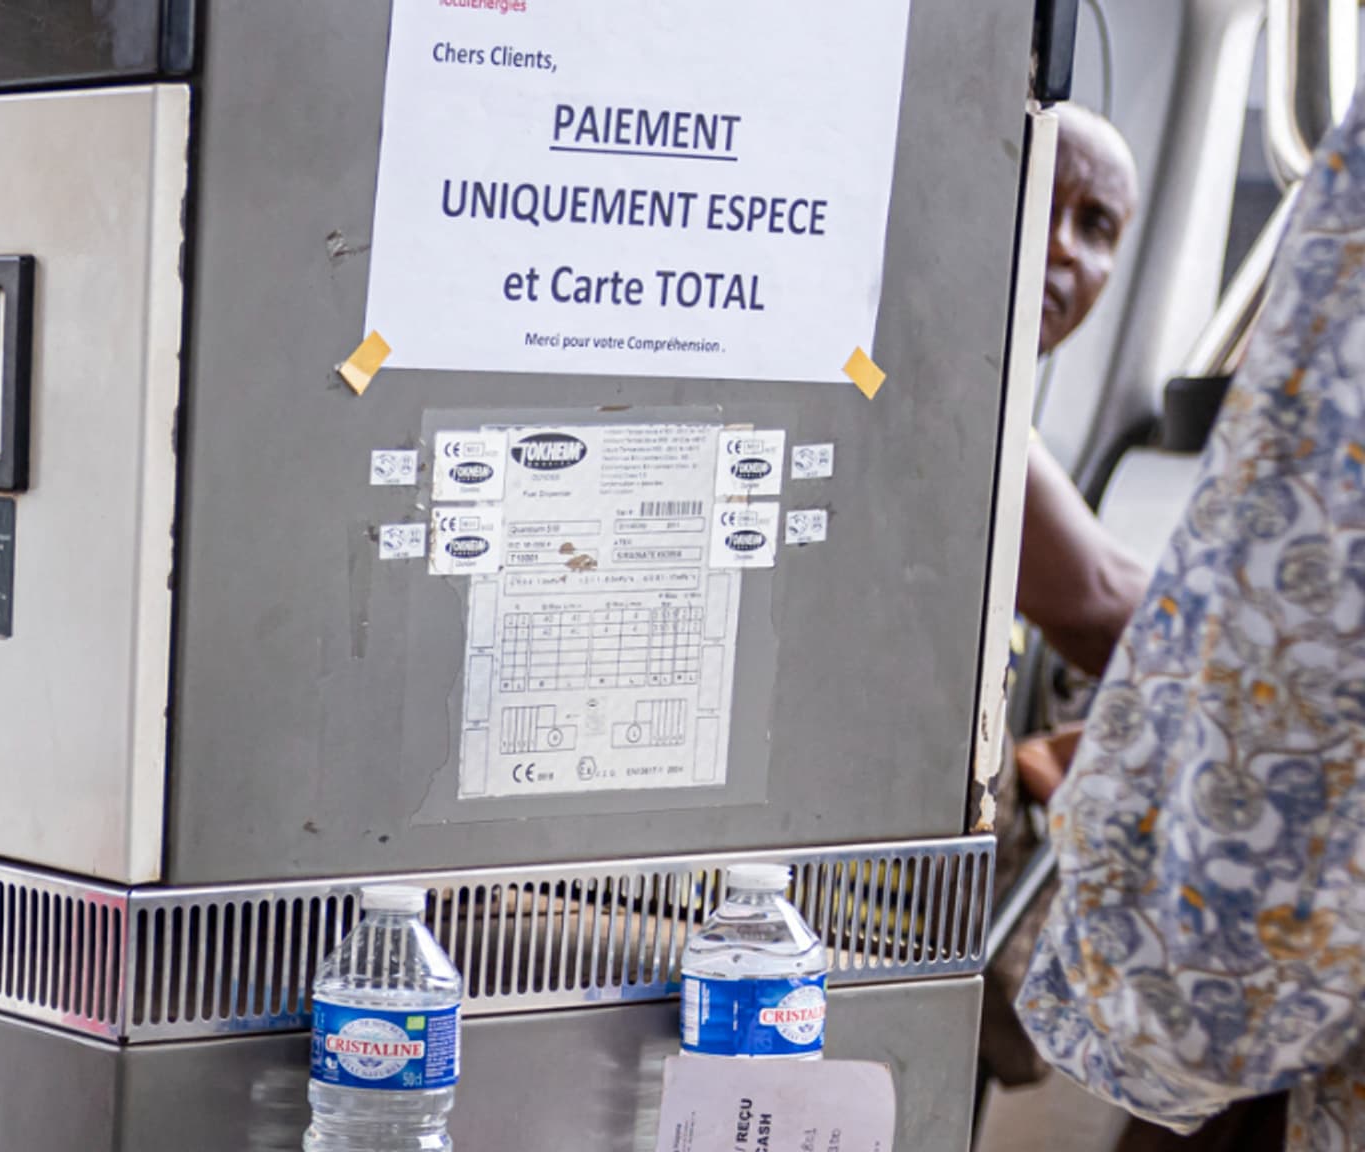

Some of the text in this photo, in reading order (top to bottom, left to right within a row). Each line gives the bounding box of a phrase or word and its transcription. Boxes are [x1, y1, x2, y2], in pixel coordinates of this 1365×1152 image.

[432, 41, 558, 73] Chers Clients,
[552, 103, 742, 153] PAIEMENT
[441, 179, 828, 236] UNIQUEMENT ESPECE
[502, 265, 765, 311] et Carte TOTAL
[524, 332, 561, 348] Merci
[562, 335, 591, 351] pour
[592, 335, 625, 350] votre
[627, 336, 720, 353] Compréhension
[512, 440, 585, 467] TOKHEIM
[760, 1006, 826, 1024] CRISTALI
[326, 1036, 422, 1057] CRISTALINE
[735, 1097, 754, 1142] REÇU
